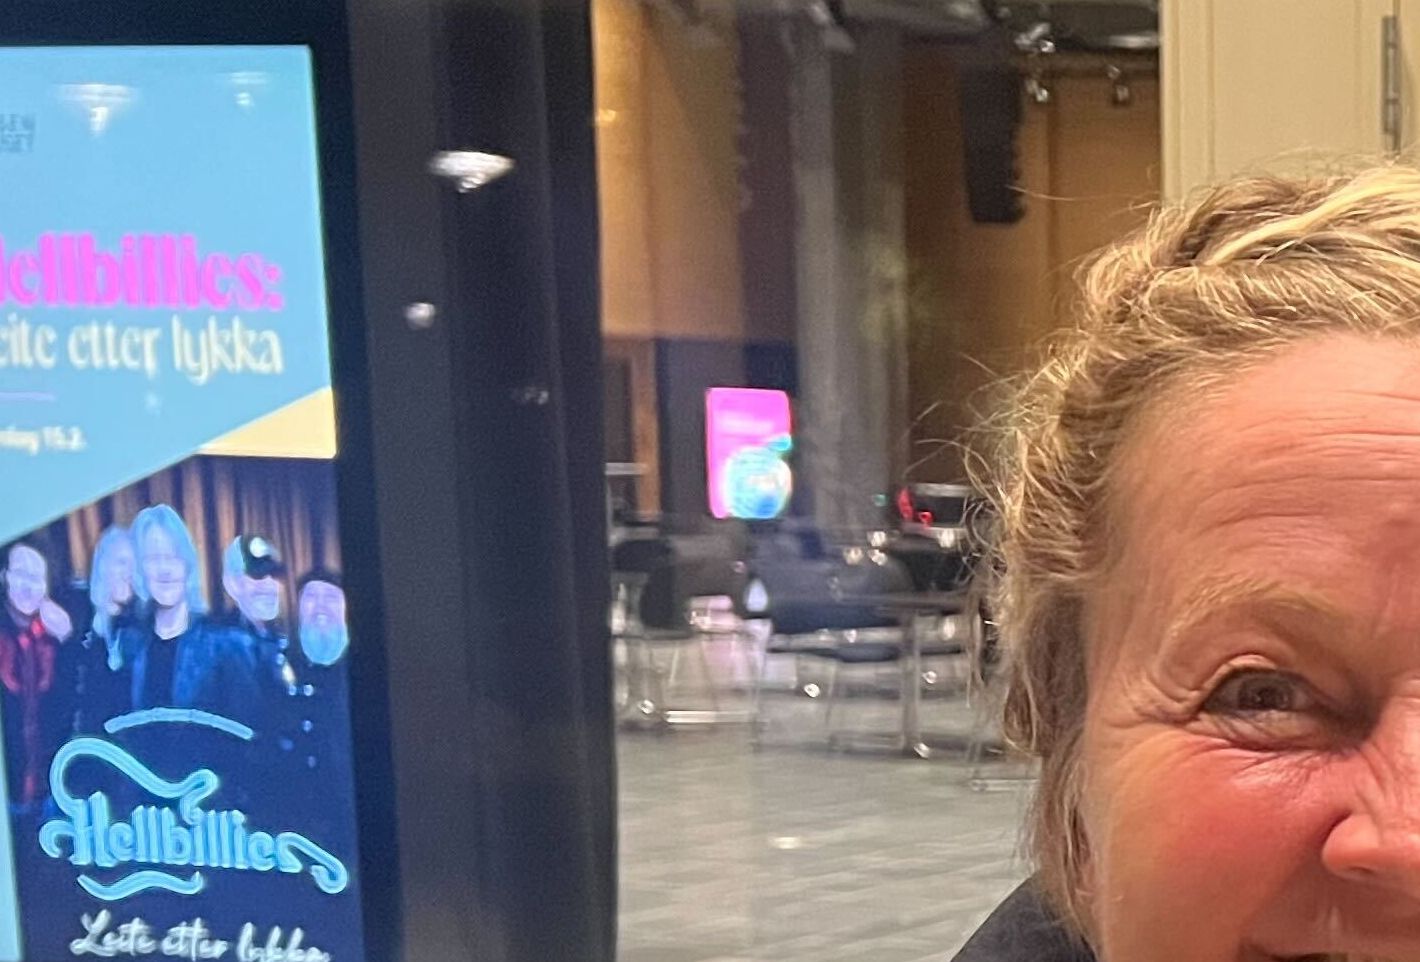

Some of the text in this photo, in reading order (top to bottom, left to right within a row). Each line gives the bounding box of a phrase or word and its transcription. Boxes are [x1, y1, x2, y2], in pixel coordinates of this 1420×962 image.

[0, 232, 284, 310] ellbillies:
[67, 319, 161, 378] etter
[171, 313, 284, 385] lykka
[39, 737, 348, 894] Hellbillies
[161, 917, 228, 962] etter
